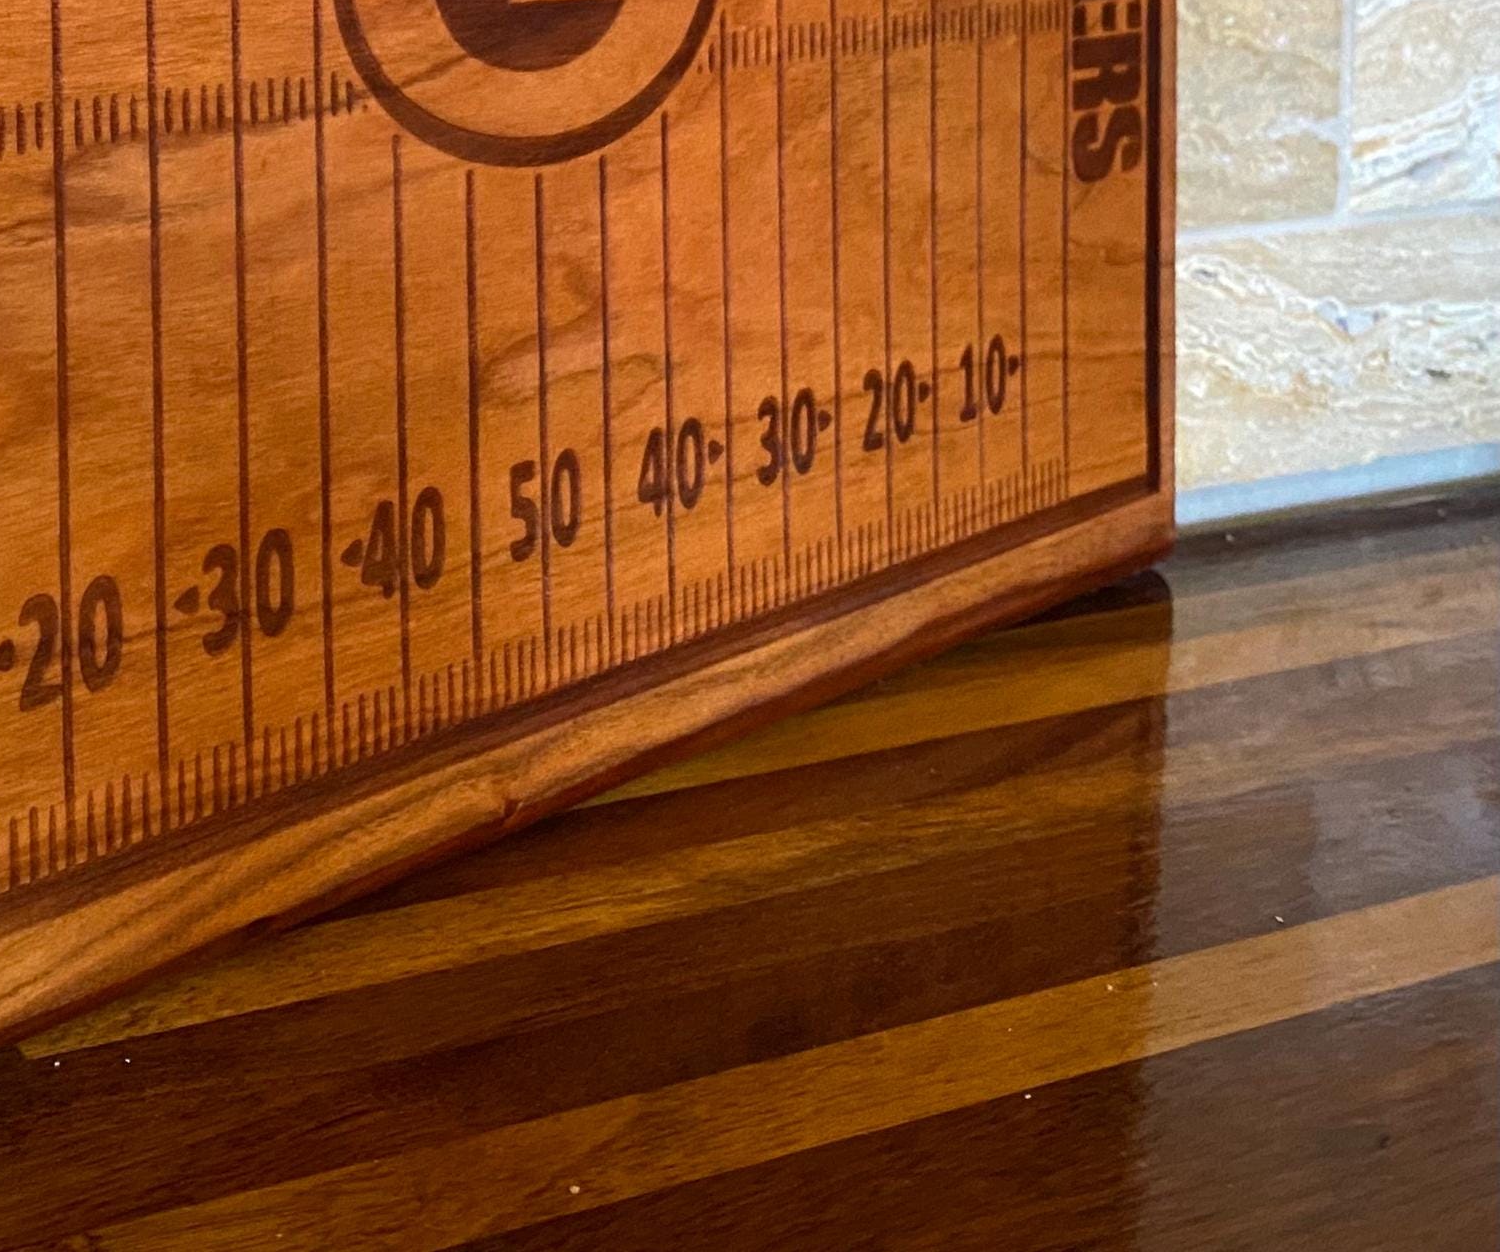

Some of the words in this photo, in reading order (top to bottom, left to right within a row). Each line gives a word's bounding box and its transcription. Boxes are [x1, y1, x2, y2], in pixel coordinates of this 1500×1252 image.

[19, 575, 123, 712] 20
[202, 528, 294, 656] 30
[361, 486, 446, 599] 40
[509, 449, 582, 561] 50
[637, 417, 702, 518] 40
[757, 387, 817, 486] 30
[862, 360, 916, 451] 20
[959, 334, 1006, 423] 10
